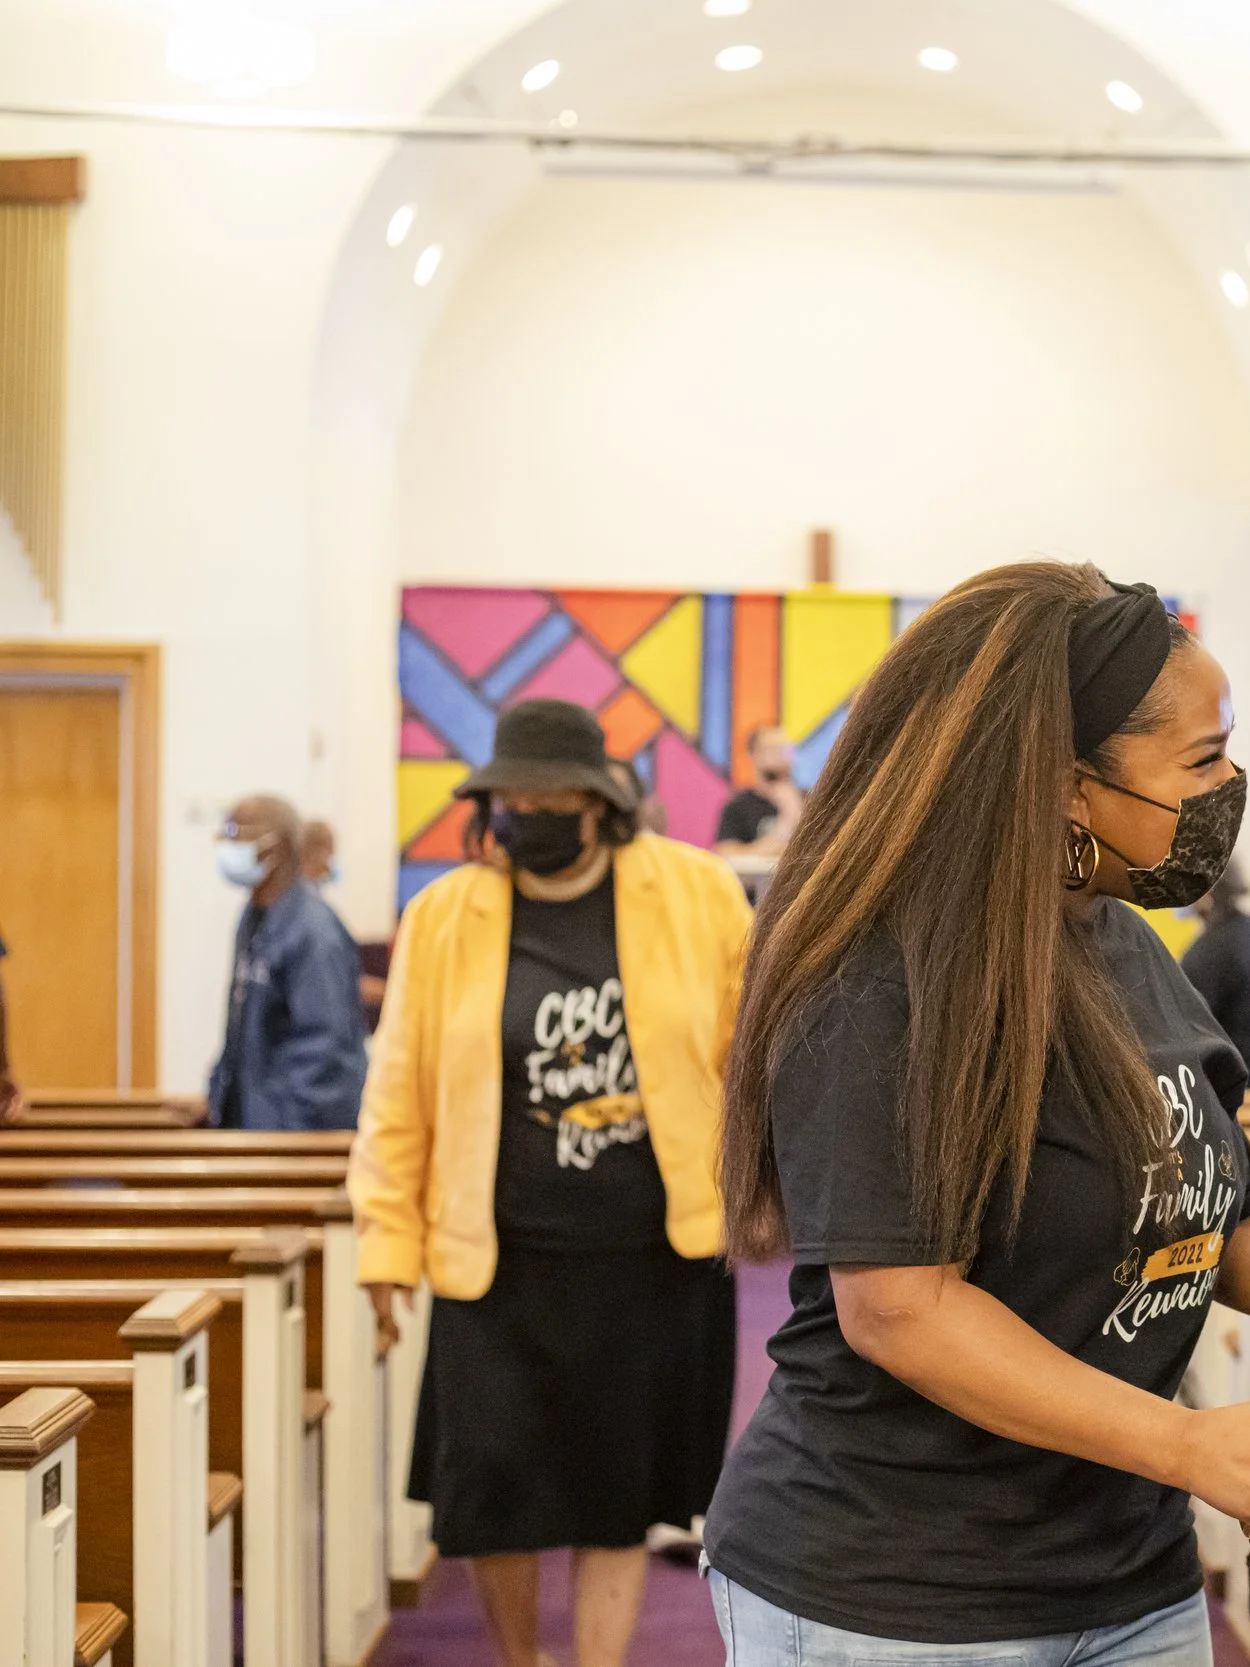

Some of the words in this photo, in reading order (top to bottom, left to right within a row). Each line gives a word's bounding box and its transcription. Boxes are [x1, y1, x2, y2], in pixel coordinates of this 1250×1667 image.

[534, 977, 624, 1049] CBC
[1147, 1064, 1203, 1148] BC
[1168, 1242, 1204, 1267] 2022
